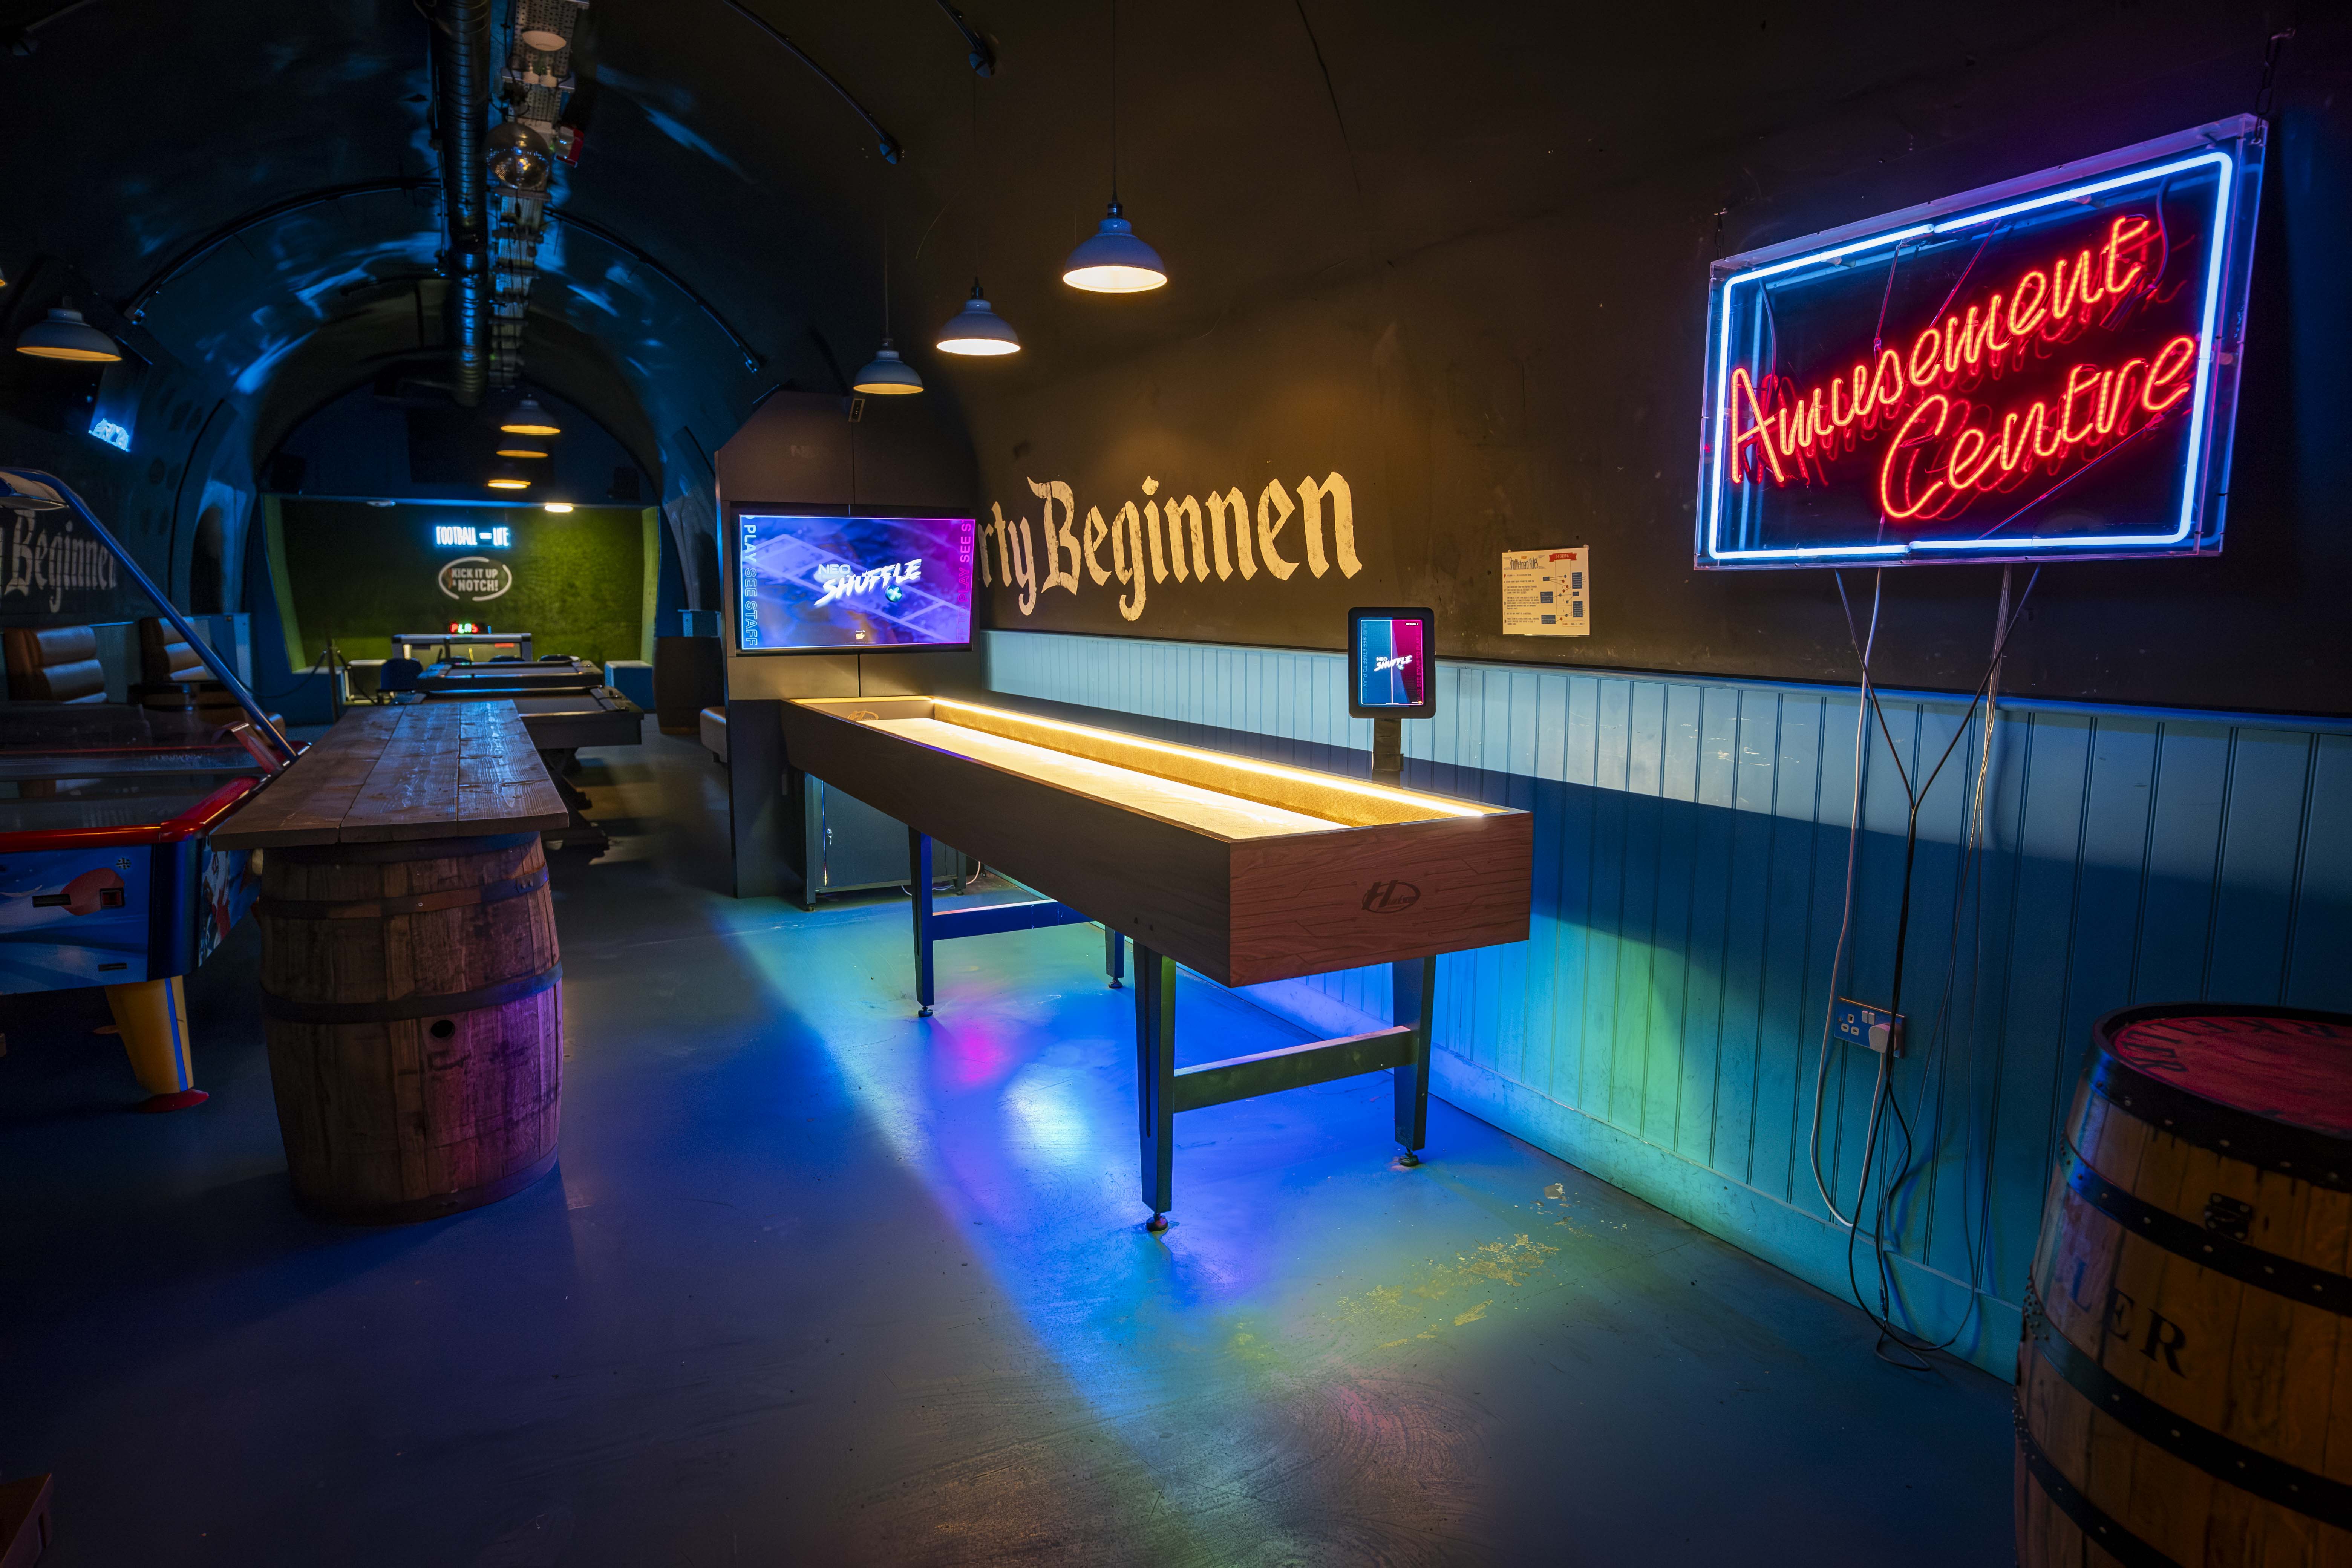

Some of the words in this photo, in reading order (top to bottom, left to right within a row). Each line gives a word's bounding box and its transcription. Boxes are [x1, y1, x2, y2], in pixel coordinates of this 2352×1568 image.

[1730, 216, 2150, 484] Amusement
[1880, 335, 2194, 518] Centre
[436, 527, 477, 545] FOOTBALL
[744, 524, 756, 562] PLAY
[960, 537, 971, 562] SEE
[1027, 471, 1363, 621] Beginnen
[452, 568, 473, 579] KICK
[475, 568, 484, 579] IT
[485, 568, 498, 579] UP
[458, 579, 499, 592] NOTCH!
[744, 568, 757, 596] SEE
[814, 559, 922, 606] SHUFFLE
[818, 564, 851, 574] NEO
[958, 568, 970, 602] PLAY
[745, 601, 758, 646] STAFF
